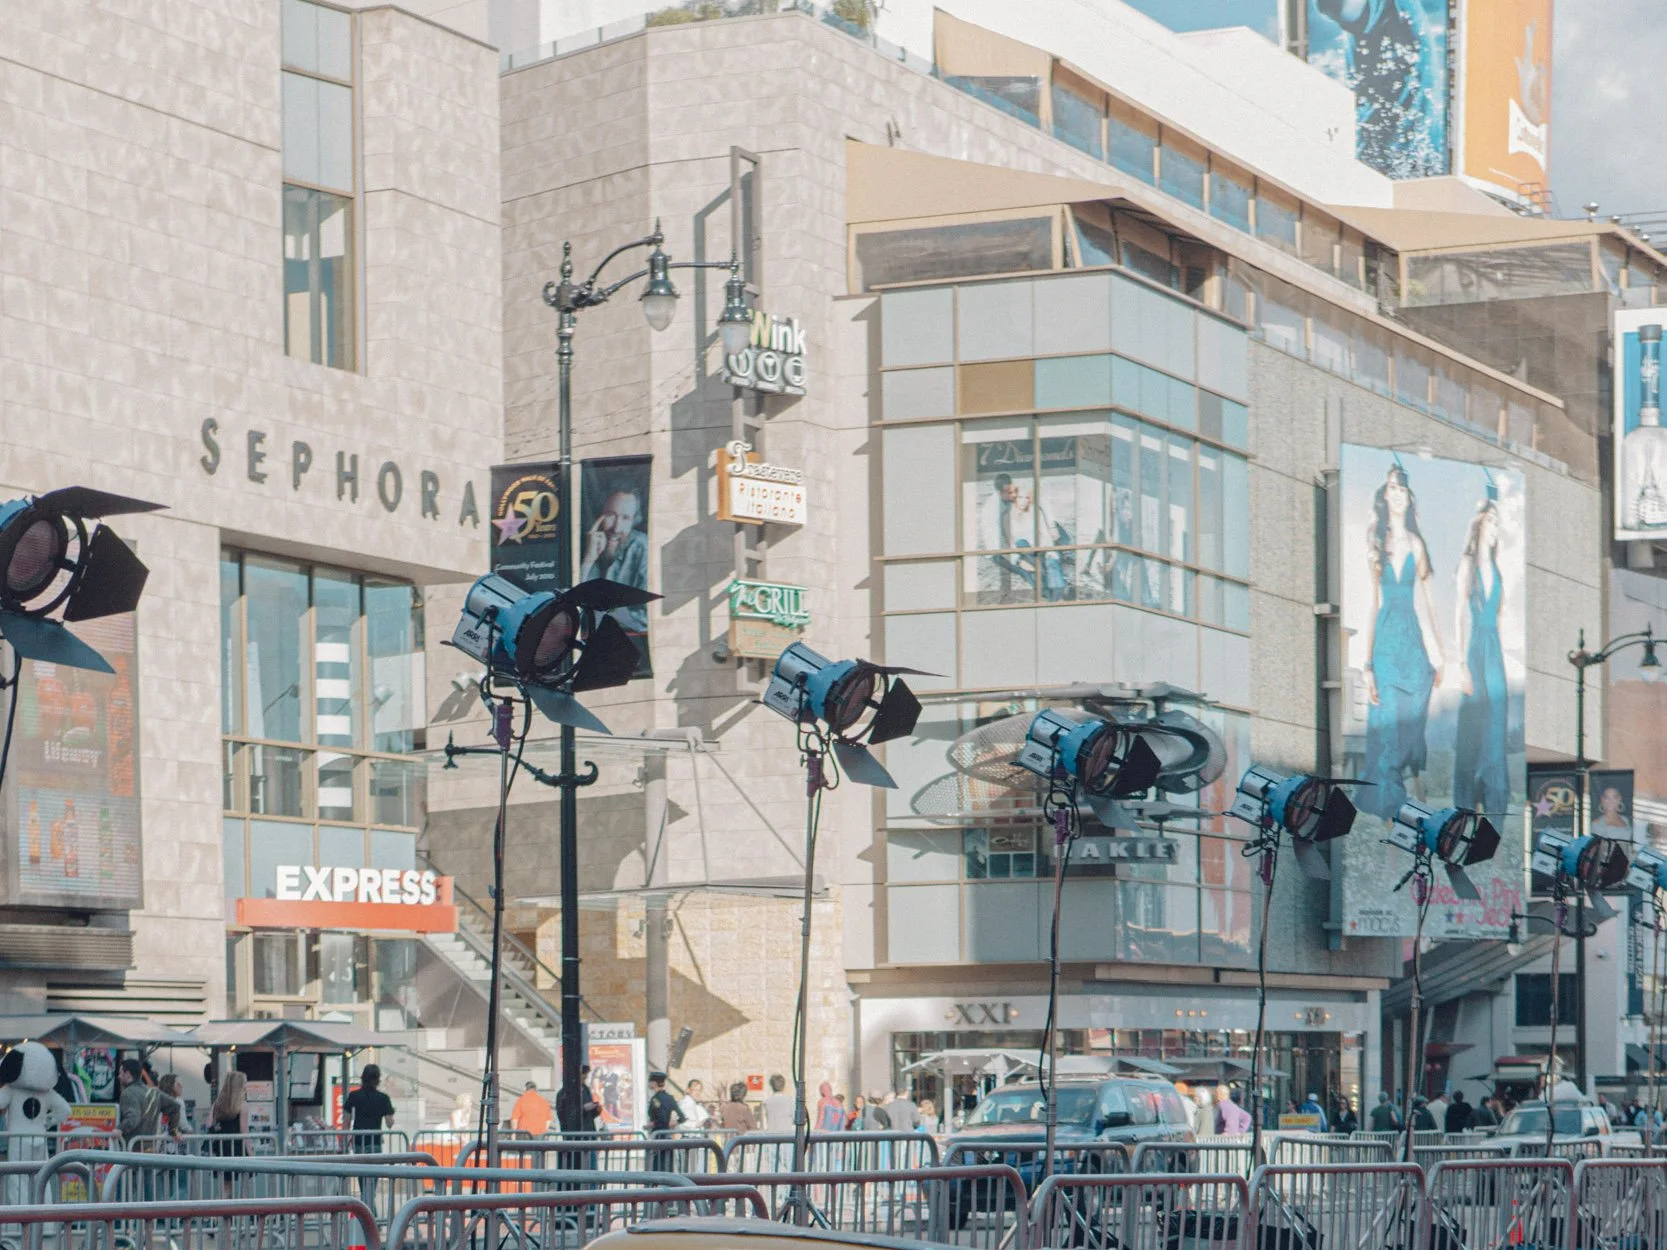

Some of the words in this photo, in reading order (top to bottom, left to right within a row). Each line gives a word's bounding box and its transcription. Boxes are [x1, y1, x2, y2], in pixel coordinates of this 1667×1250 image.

[748, 308, 807, 356] Wink
[200, 417, 480, 529] SEPHORA
[738, 481, 802, 504] Ristorante
[509, 490, 559, 540] 50
[275, 865, 437, 906] EXPRESS
[954, 1002, 1013, 1025] XXI
